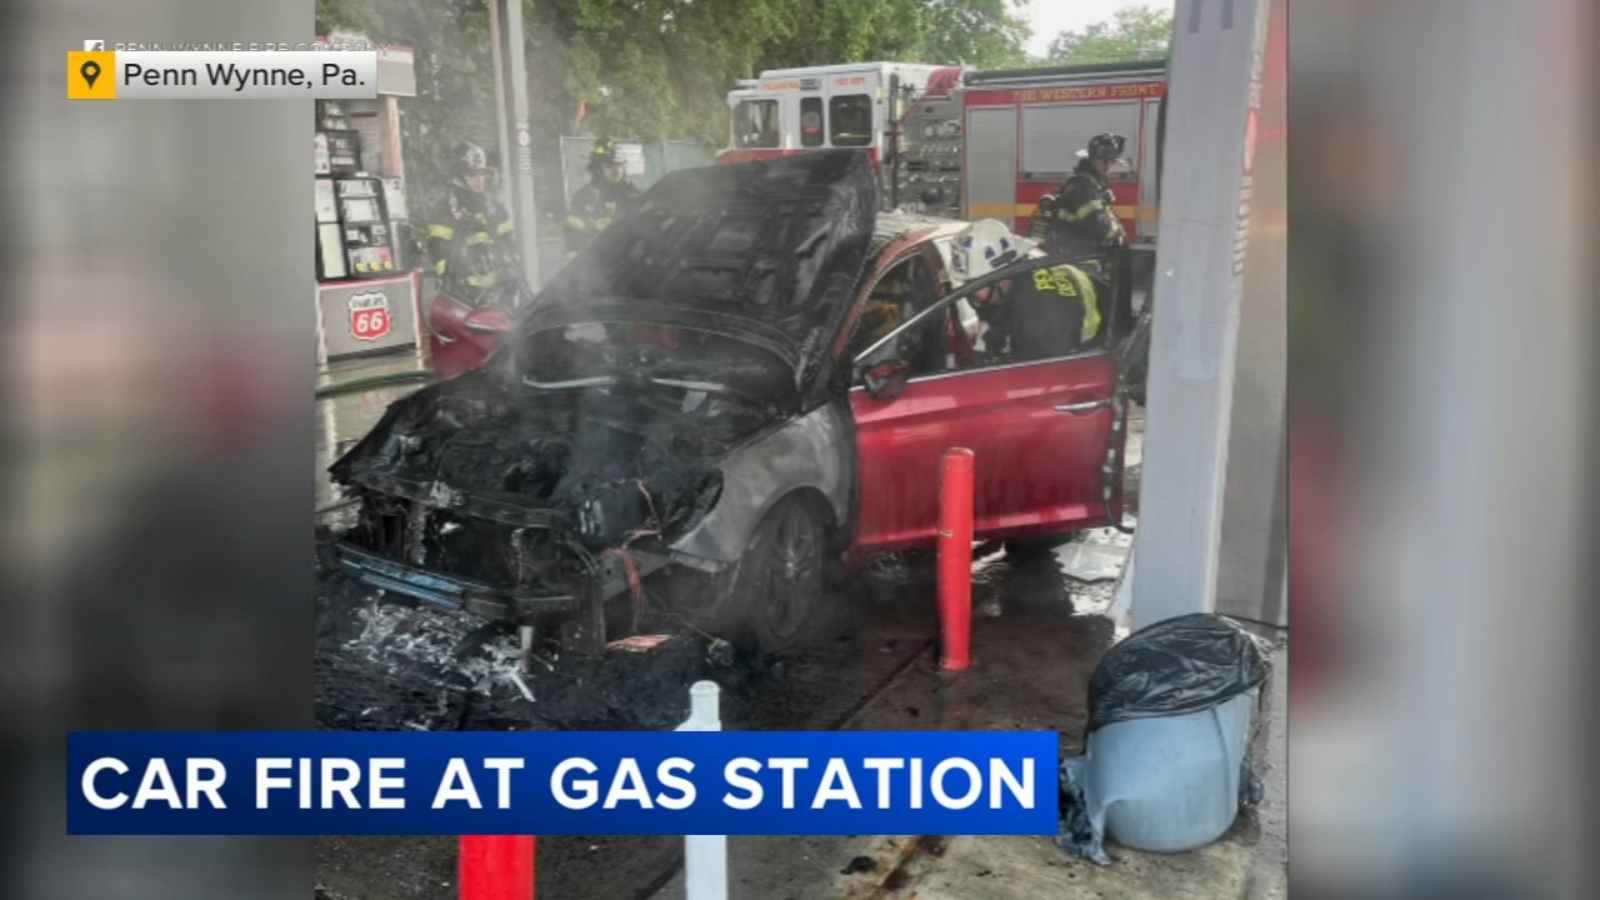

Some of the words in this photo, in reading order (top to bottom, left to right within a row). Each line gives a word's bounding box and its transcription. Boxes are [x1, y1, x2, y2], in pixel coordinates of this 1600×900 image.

[1013, 90, 1037, 101] THE
[1040, 86, 1107, 100] WESTERN
[1111, 83, 1160, 97] FRONT
[356, 311, 383, 333] 66
